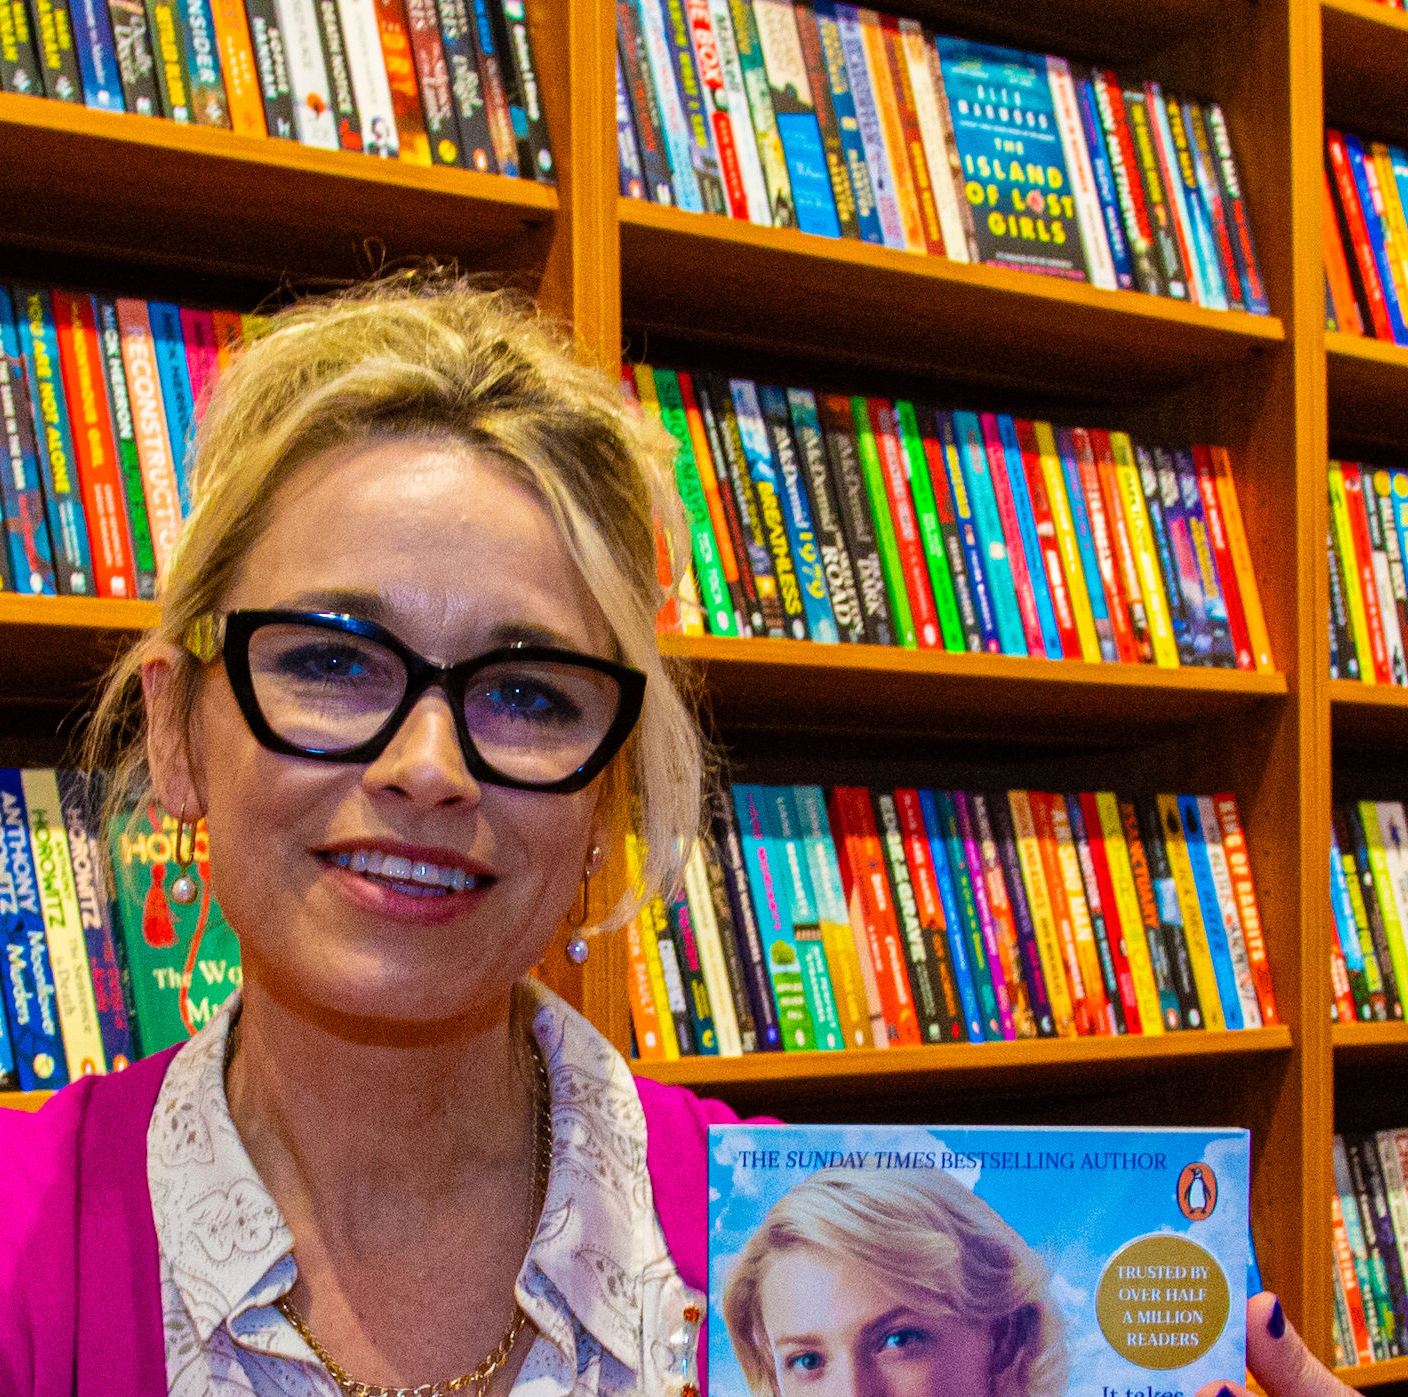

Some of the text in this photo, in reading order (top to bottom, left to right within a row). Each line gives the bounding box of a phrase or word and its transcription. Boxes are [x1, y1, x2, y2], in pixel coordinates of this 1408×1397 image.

[966, 154, 1062, 189] ISLAND
[988, 212, 1066, 245] GIRLS
[46, 426, 68, 493] ALONE
[757, 481, 802, 614] BREATHLESS
[0, 790, 37, 913] ANTHONY
[31, 808, 67, 928] HOROWITZ
[7, 944, 29, 1026] Murders
[738, 1151, 1167, 1170] THE SUNDAY TIMES BESTSELLING AUTHOR
[1117, 1265, 1210, 1280] TRUSTED BY
[1119, 1288, 1208, 1302] OVER HALF
[1122, 1310, 1204, 1325] A MILLION
[1127, 1332, 1199, 1347] READERS
